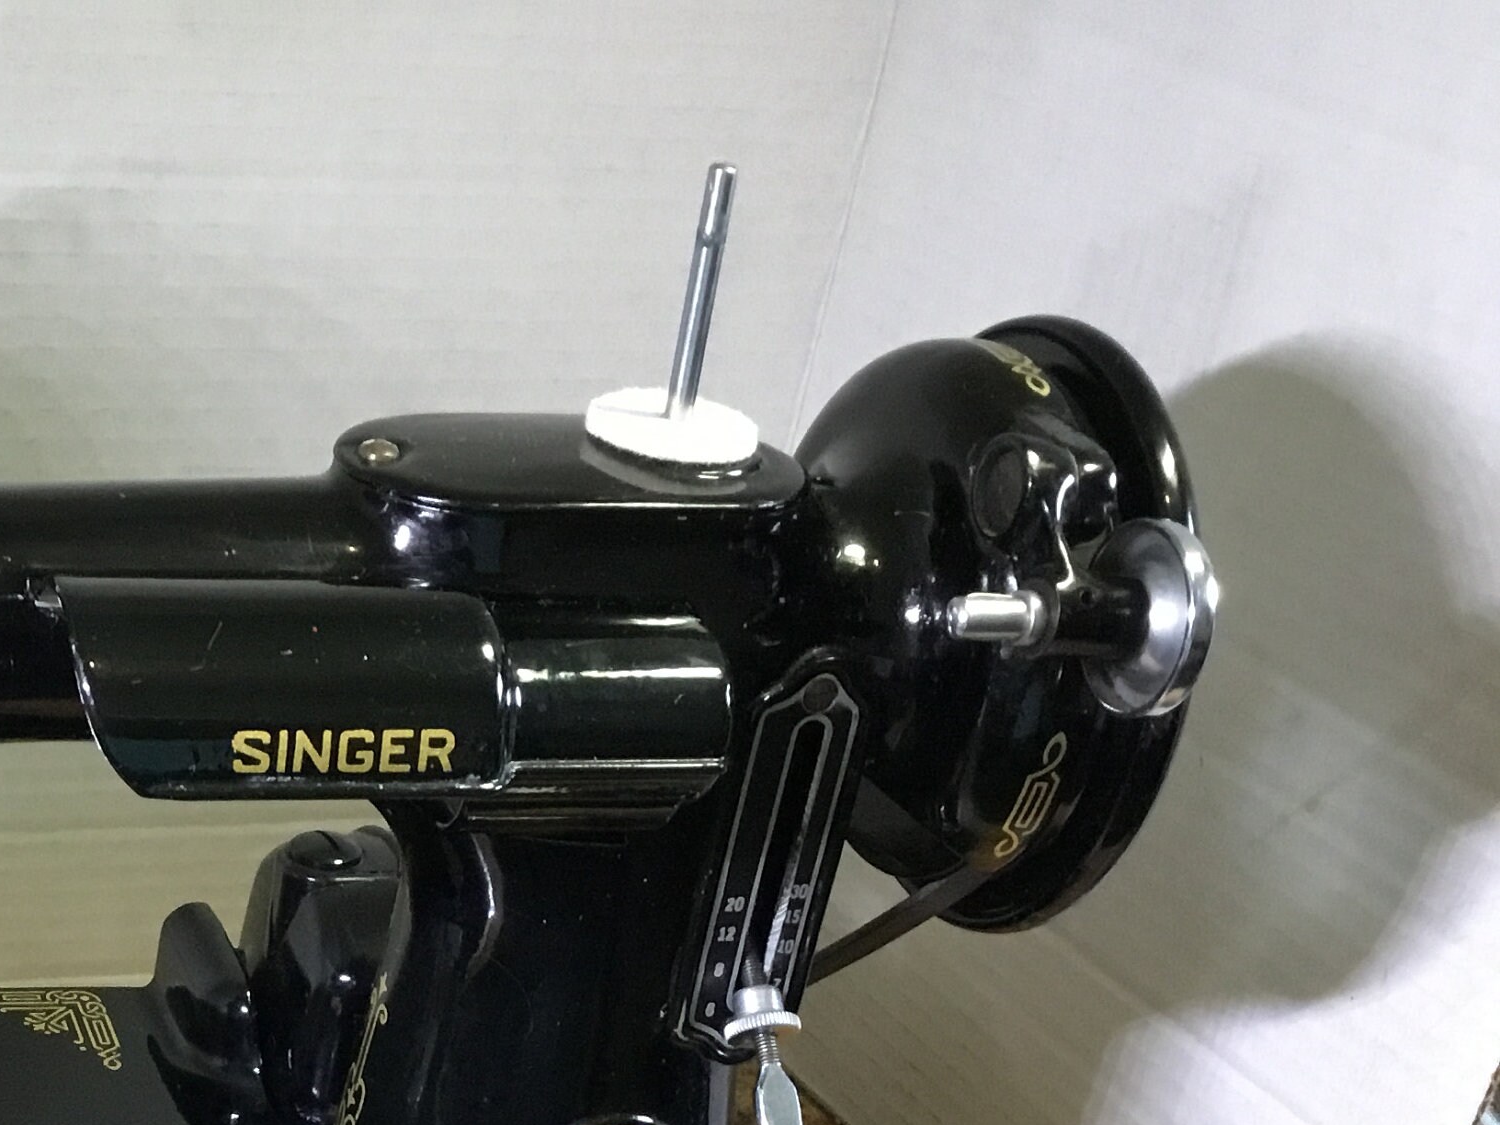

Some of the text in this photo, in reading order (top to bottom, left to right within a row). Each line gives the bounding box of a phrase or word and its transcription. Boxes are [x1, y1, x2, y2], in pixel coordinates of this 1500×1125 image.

[231, 728, 456, 773] SINGER
[791, 884, 809, 899] 30
[724, 896, 745, 912] 20
[785, 909, 802, 924] 15
[717, 926, 736, 941] 12
[777, 940, 795, 954] 10
